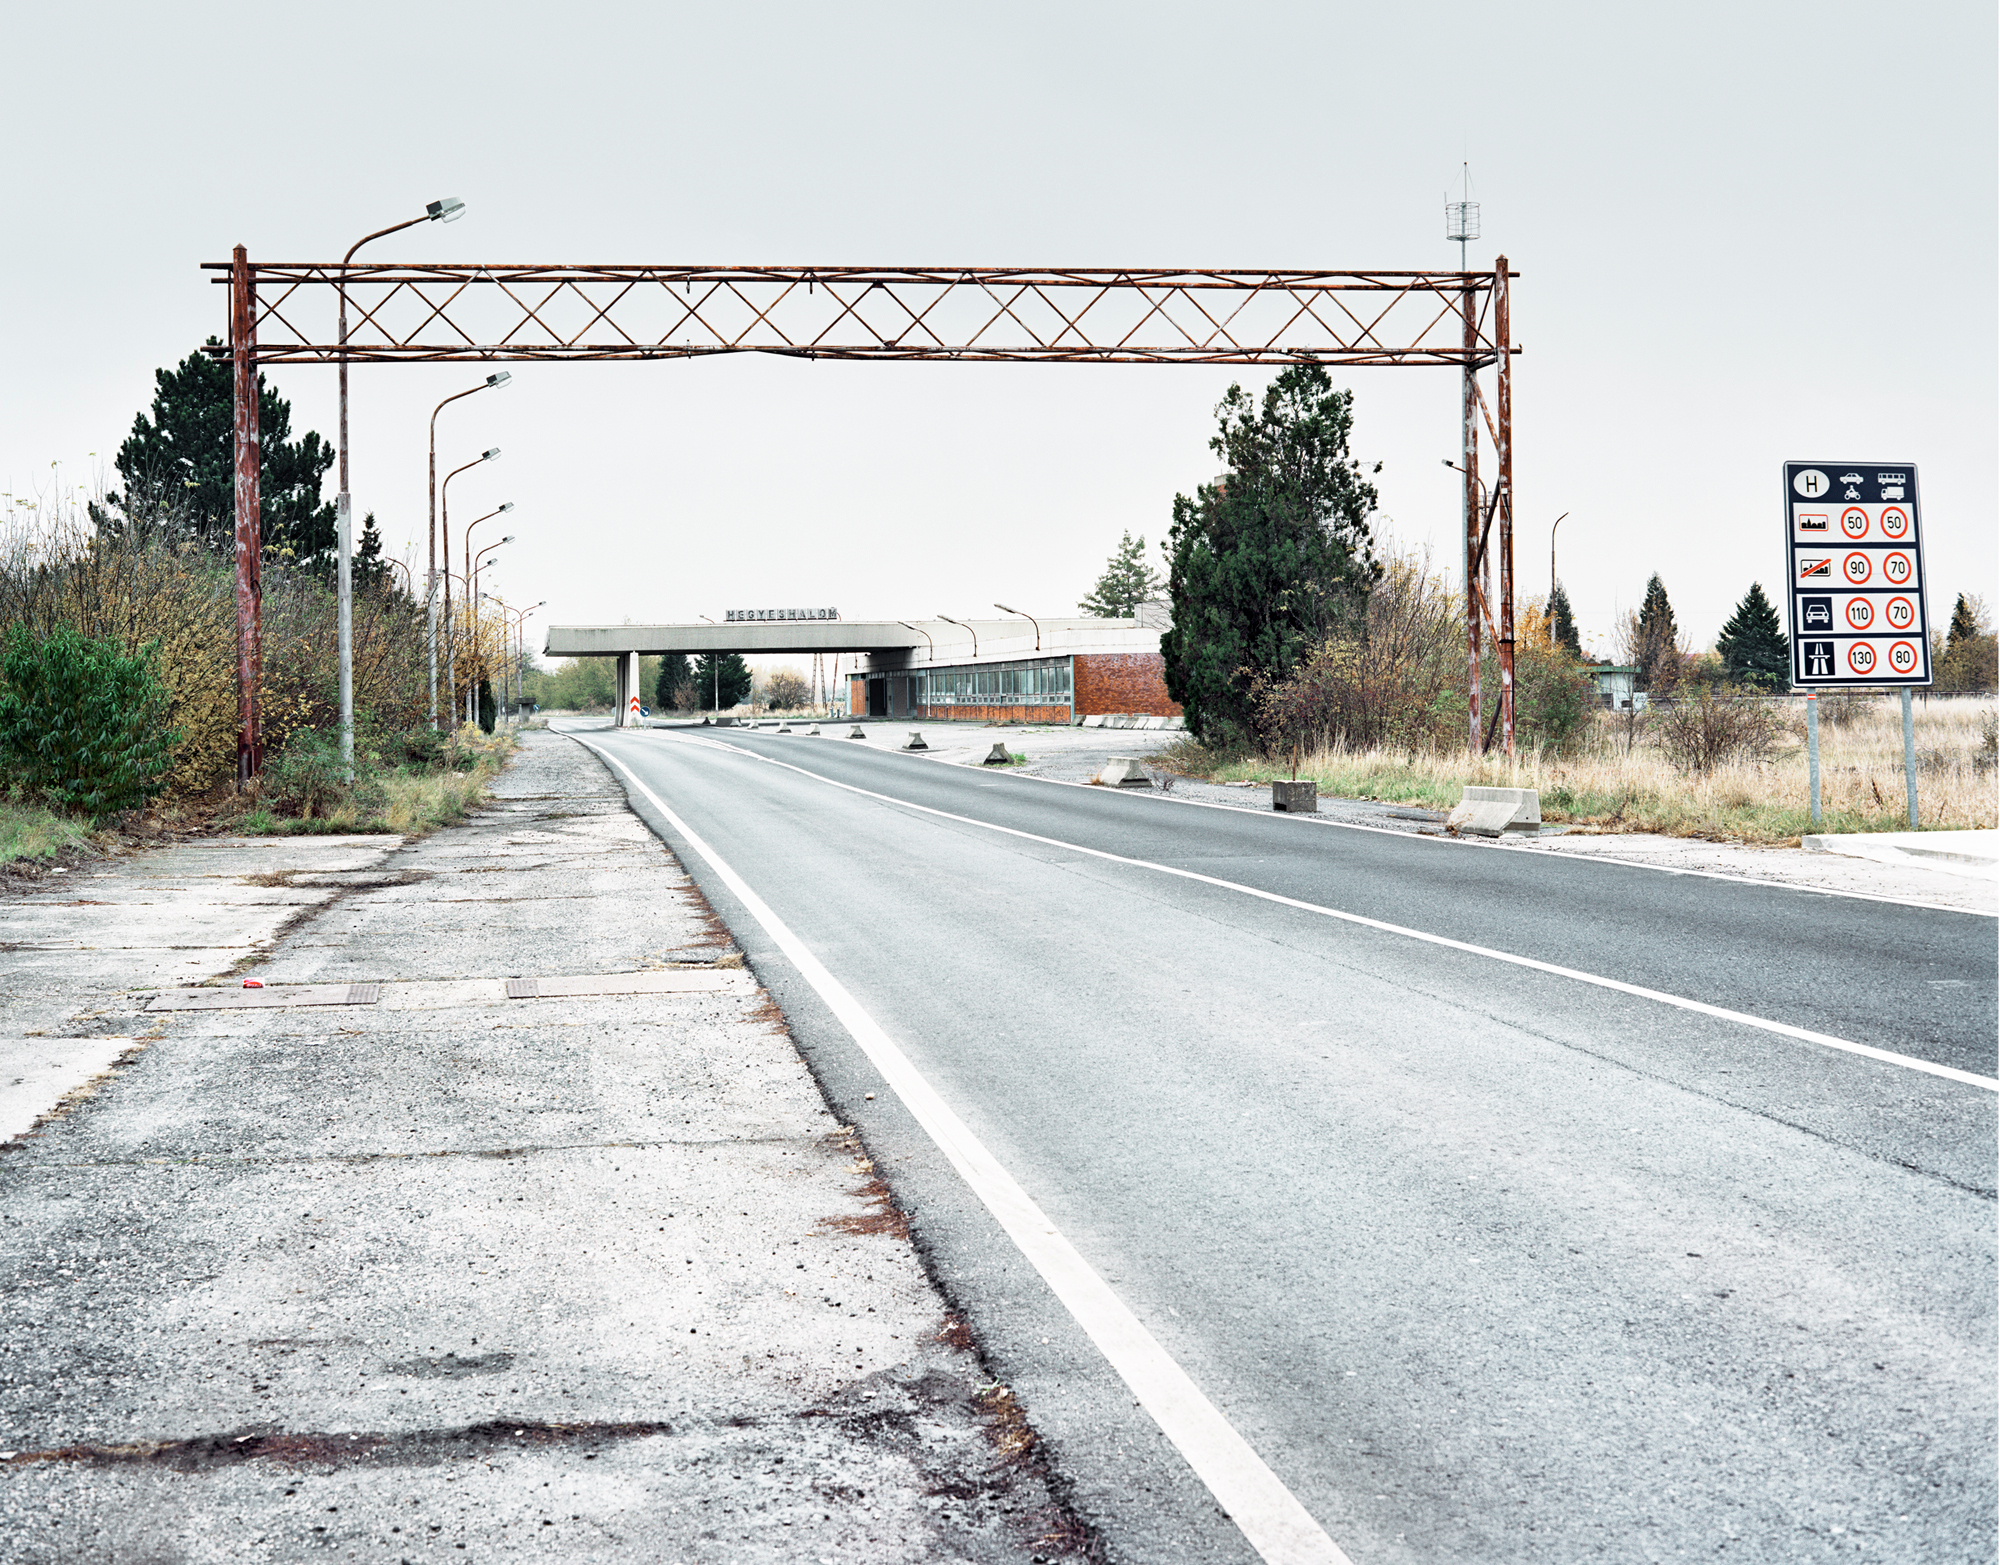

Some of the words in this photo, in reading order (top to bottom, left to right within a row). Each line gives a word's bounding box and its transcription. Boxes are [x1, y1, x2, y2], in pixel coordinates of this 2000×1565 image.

[1806, 475, 1818, 492] H
[1848, 516, 1862, 530] 50
[1887, 515, 1902, 529] 50
[1850, 561, 1865, 574] 90
[1891, 561, 1905, 574] 70
[727, 609, 837, 620] HEGYESHALOM
[1851, 606, 1868, 620] 110
[1893, 606, 1908, 619] 70
[1852, 651, 1872, 664] 130
[1896, 650, 1911, 664] 80
